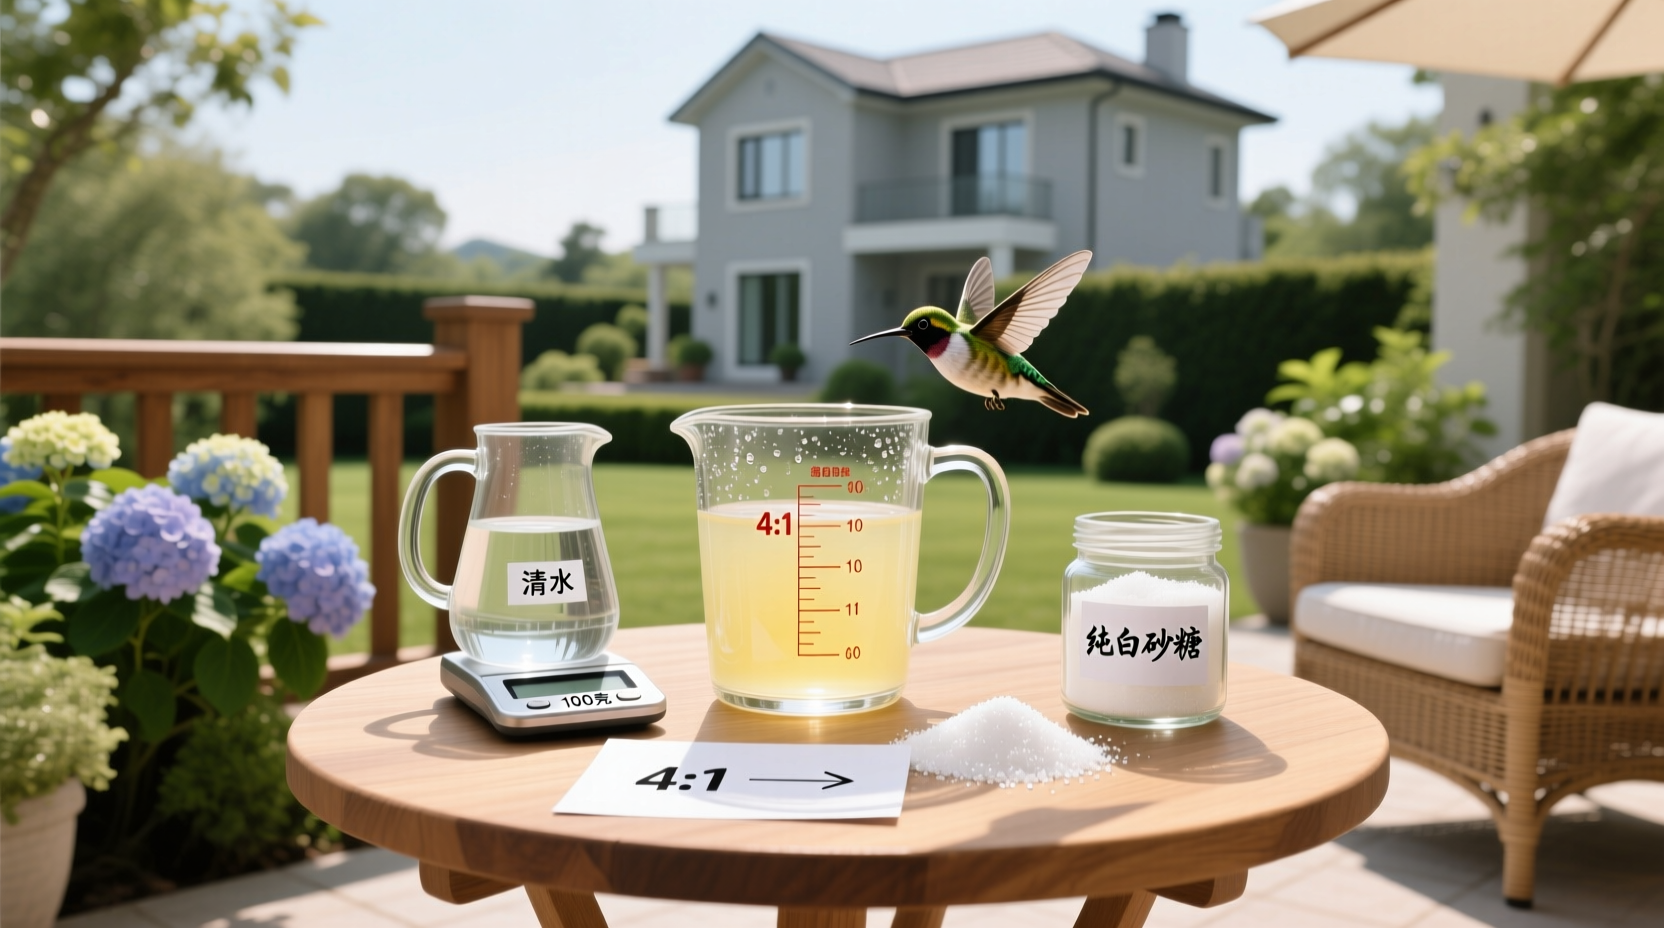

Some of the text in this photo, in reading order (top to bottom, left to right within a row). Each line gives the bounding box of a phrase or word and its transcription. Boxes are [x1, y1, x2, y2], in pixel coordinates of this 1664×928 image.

[756, 511, 792, 536] 4:1
[846, 518, 863, 533] 10
[846, 559, 863, 574] 10
[521, 567, 575, 597] 清水
[845, 602, 859, 616] 11
[1086, 624, 1203, 663] 纯白砂糖
[635, 766, 728, 792] 4:1
